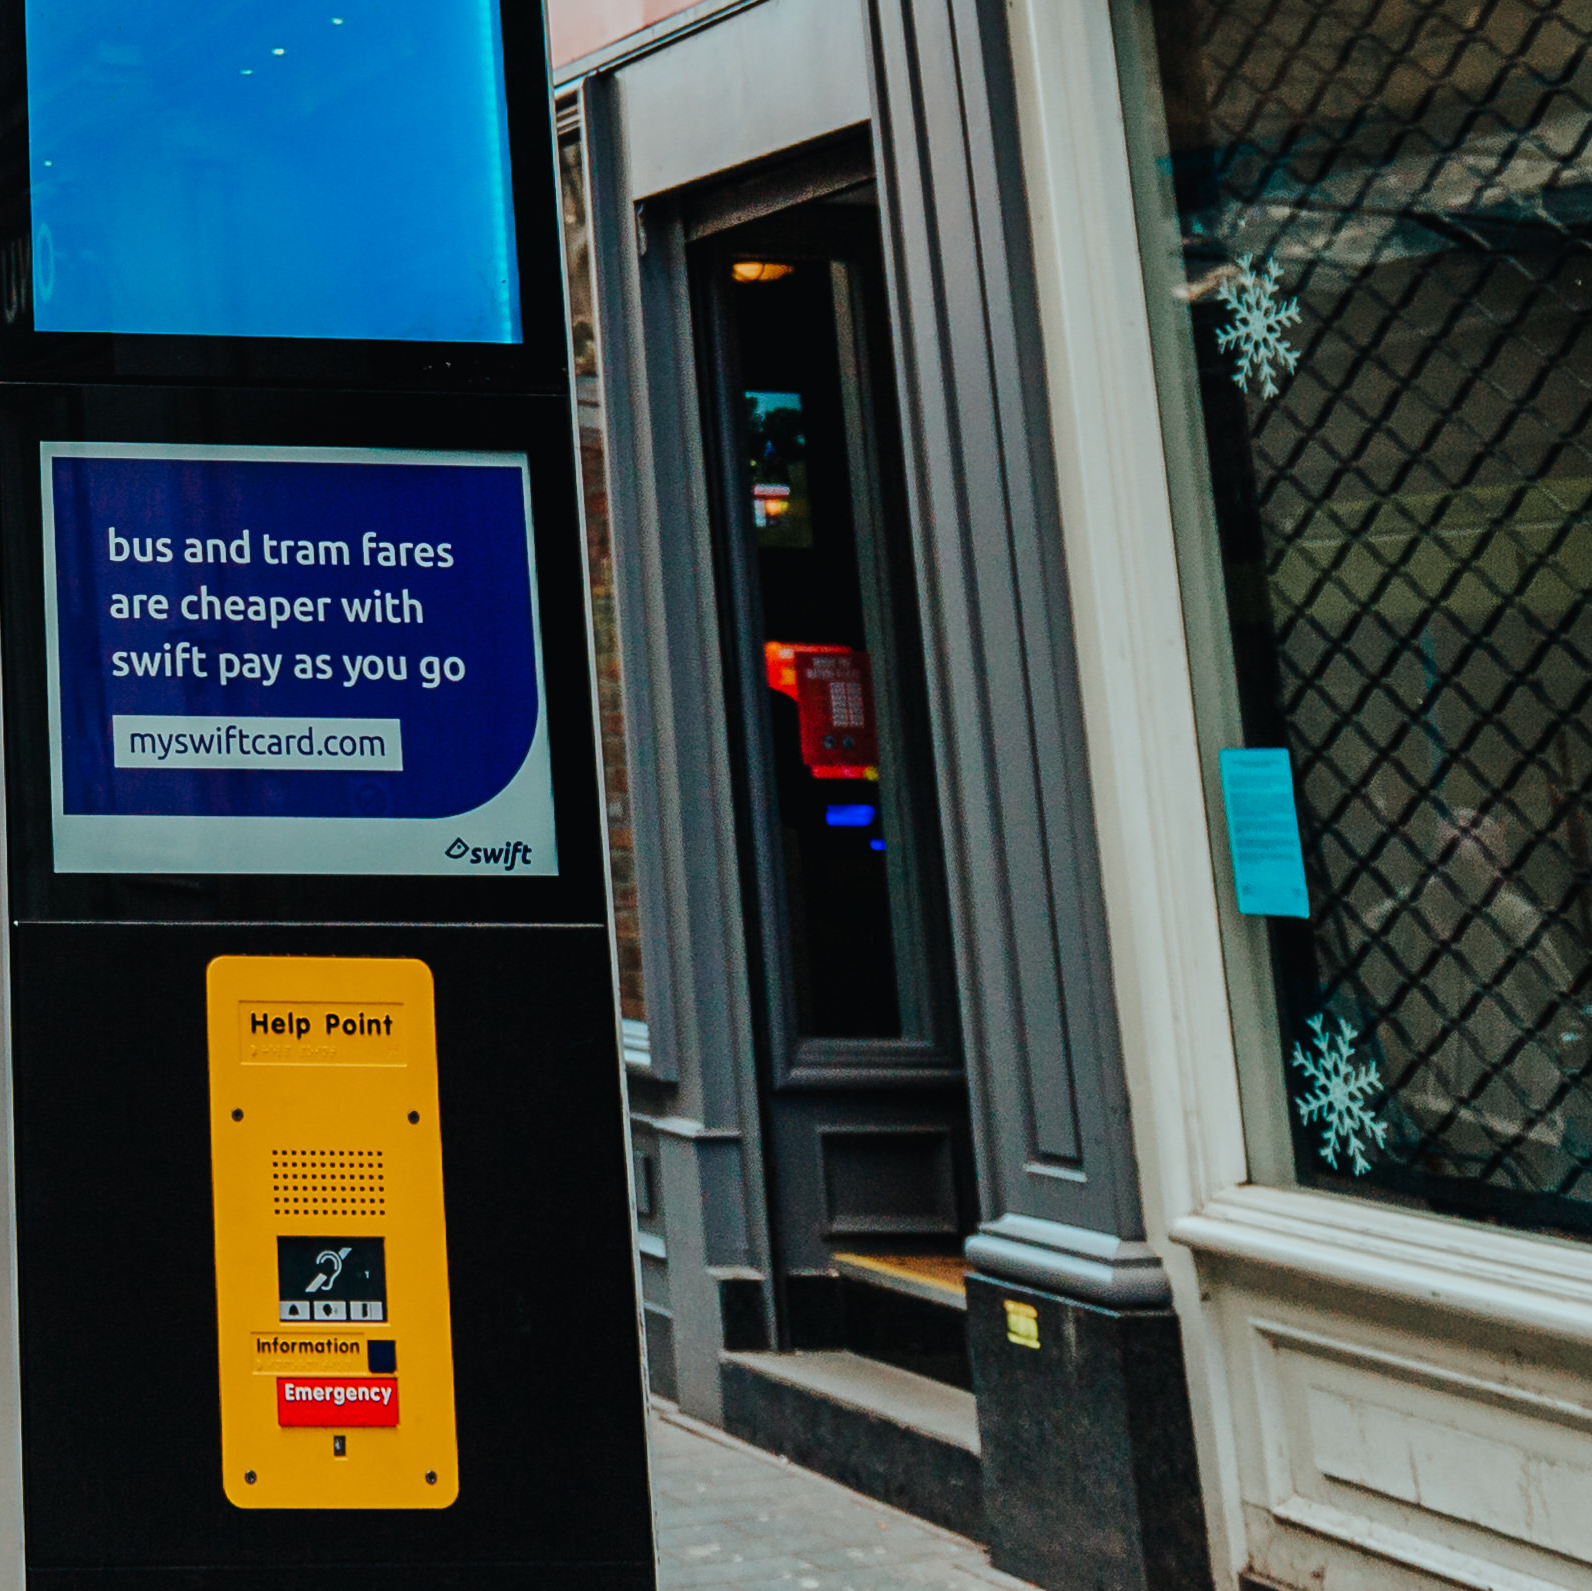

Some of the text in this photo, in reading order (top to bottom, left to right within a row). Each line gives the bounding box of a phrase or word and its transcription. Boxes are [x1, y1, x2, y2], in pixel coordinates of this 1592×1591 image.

[108, 528, 454, 568] bus and tram fares
[110, 586, 424, 628] are cheaper with
[112, 642, 466, 689] swift pay as you go
[130, 726, 386, 760] myswiftcard.com
[470, 841, 532, 871] swift
[250, 1012, 393, 1040] Help Point
[256, 1336, 361, 1356] Information
[283, 1383, 392, 1405] Emergency
